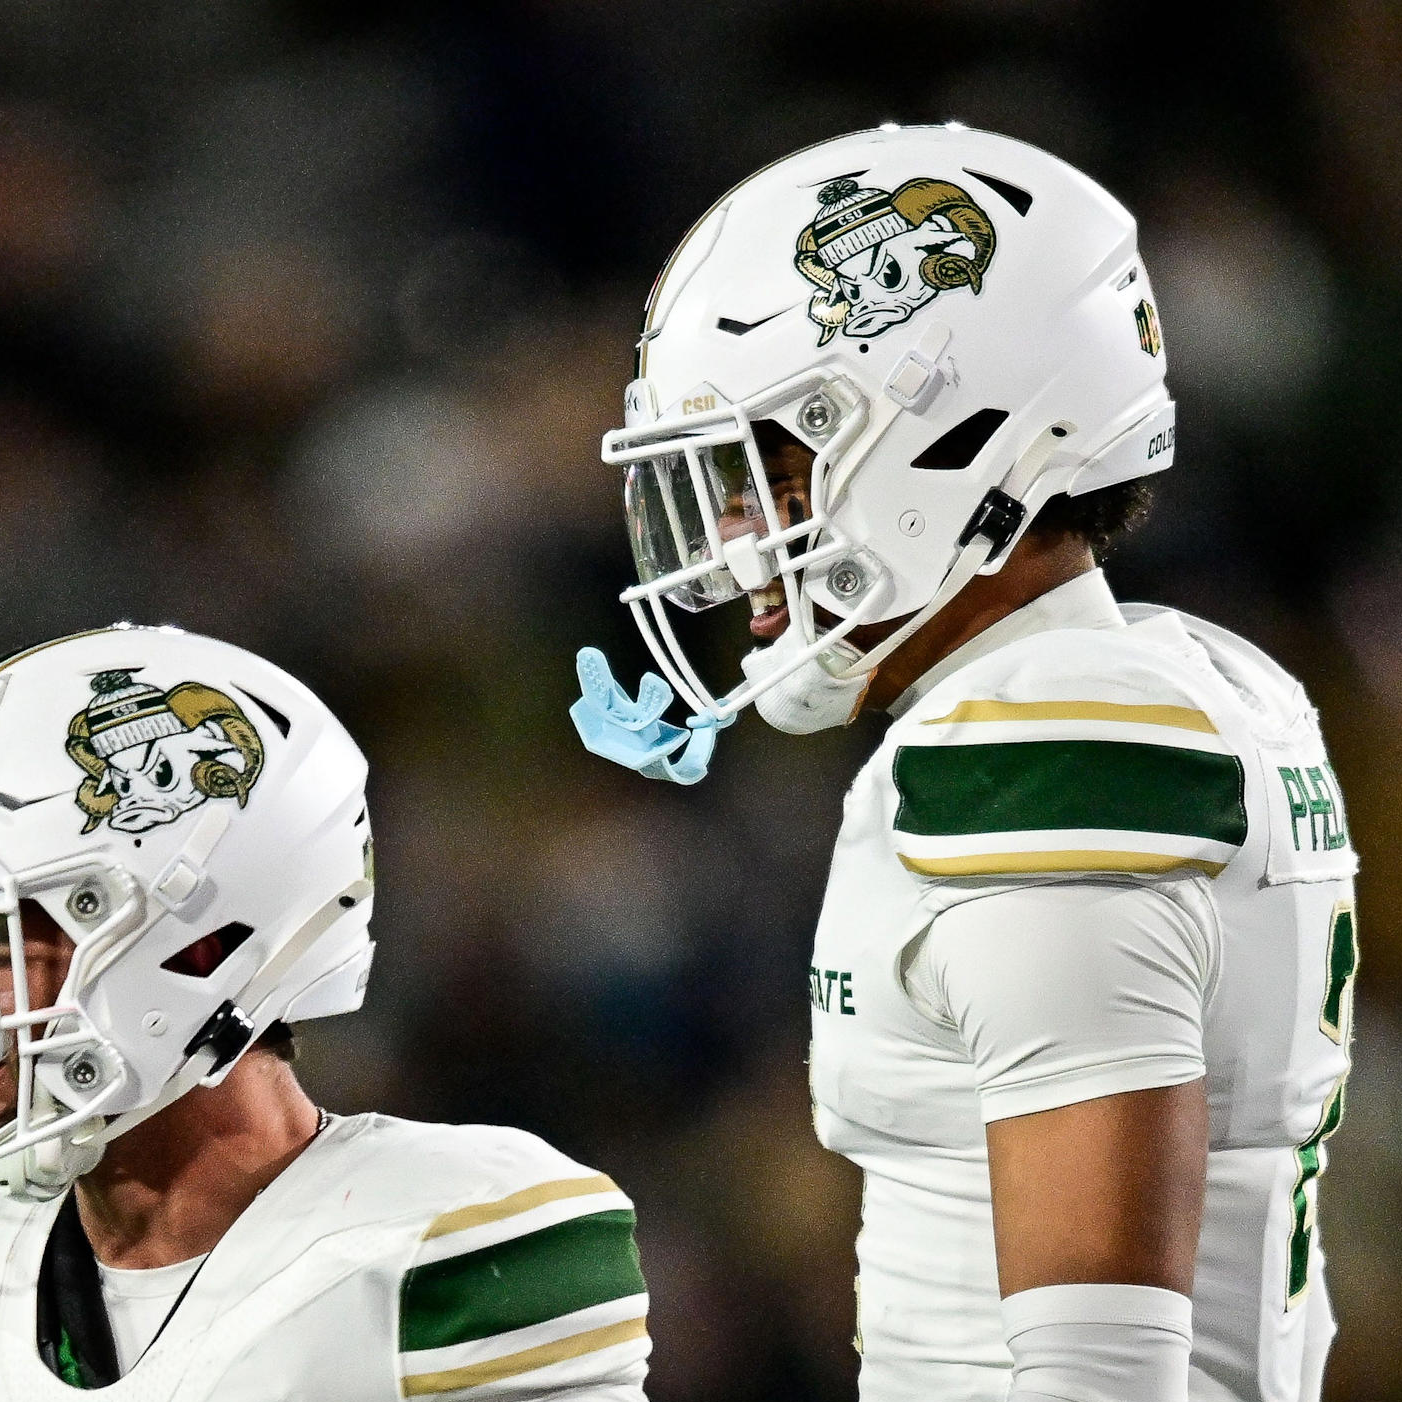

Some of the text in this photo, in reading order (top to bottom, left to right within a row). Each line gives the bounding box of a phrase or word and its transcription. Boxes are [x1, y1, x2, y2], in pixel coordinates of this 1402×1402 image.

[837, 209, 863, 226] CSU
[1148, 425, 1175, 460] COLO
[807, 966, 856, 1016] TATE
